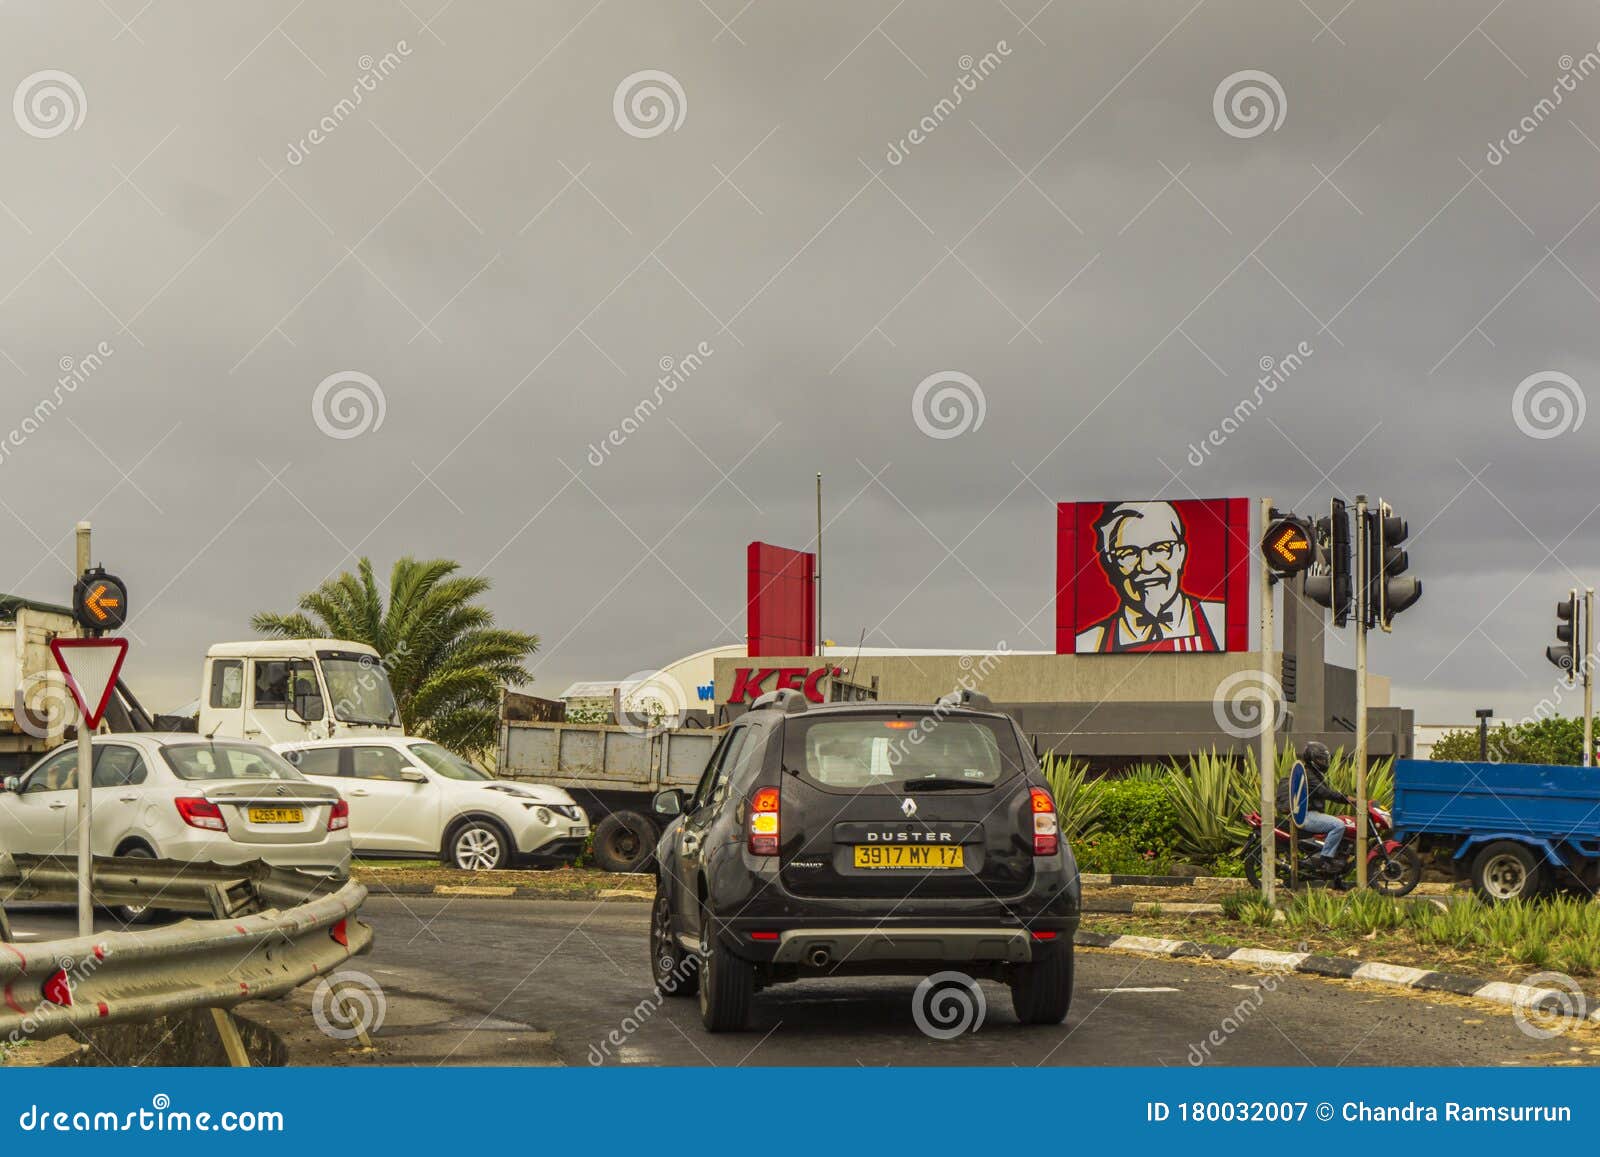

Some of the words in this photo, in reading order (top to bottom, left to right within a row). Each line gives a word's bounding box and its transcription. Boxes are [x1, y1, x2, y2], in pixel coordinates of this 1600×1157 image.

[727, 666, 842, 704] KFC
[867, 832, 952, 841] DUSTER
[860, 847, 904, 865] 3917
[910, 847, 930, 865] MY
[939, 847, 959, 865] 17
